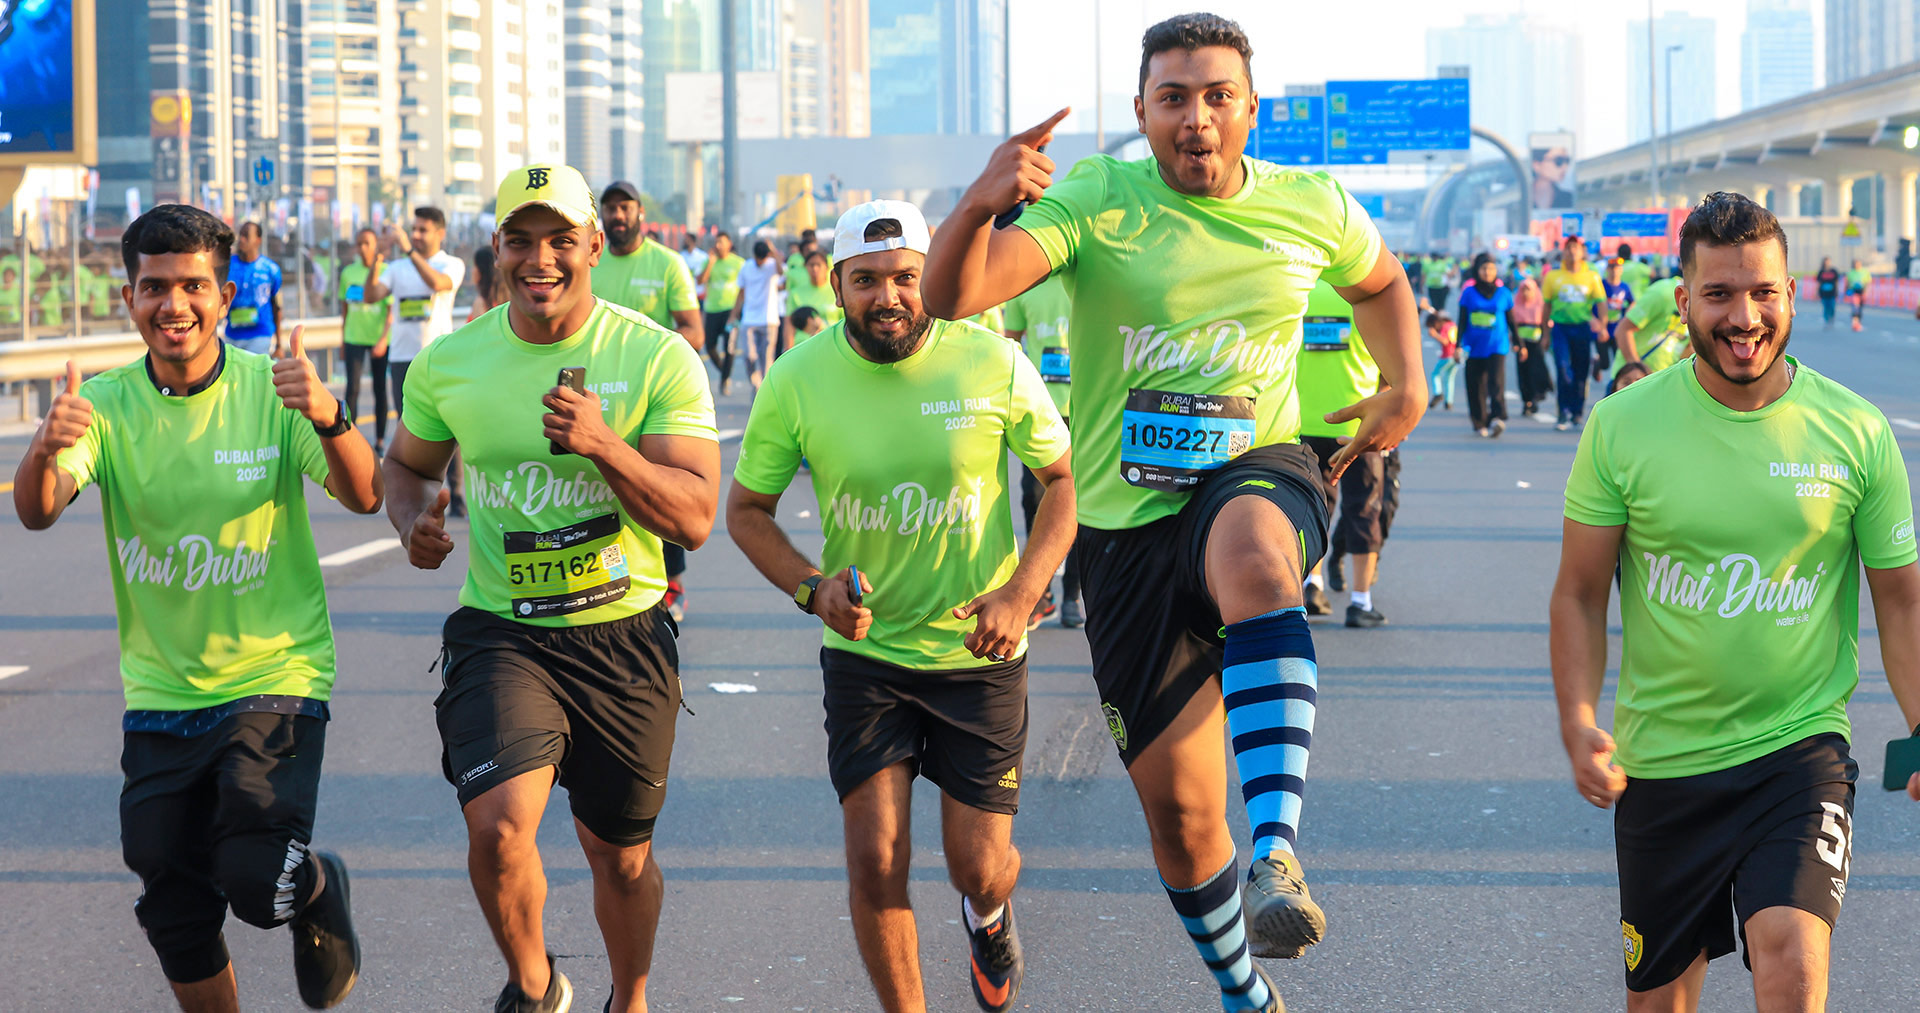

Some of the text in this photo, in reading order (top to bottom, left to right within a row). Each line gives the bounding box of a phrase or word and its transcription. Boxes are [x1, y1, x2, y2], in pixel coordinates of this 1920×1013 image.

[1118, 324, 1199, 373] Mai
[601, 381, 628, 394] RUN
[921, 397, 991, 415] DUBAI RUN
[1159, 403, 1180, 413] RUN
[1160, 394, 1192, 406] DUBAI
[945, 415, 977, 431] 2022
[1127, 423, 1225, 453] 105227
[214, 445, 280, 466] DUBAI RUN
[236, 465, 267, 483] 2022
[1769, 462, 1849, 480] DUBAI RUN
[467, 463, 518, 510] Mai
[1795, 483, 1830, 498] 2022
[832, 493, 892, 533] Mai
[116, 534, 272, 592] Mai Dubai
[510, 552, 600, 585] 517162
[1643, 552, 1824, 618] Mai Dubai
[1776, 614, 1796, 627] water
